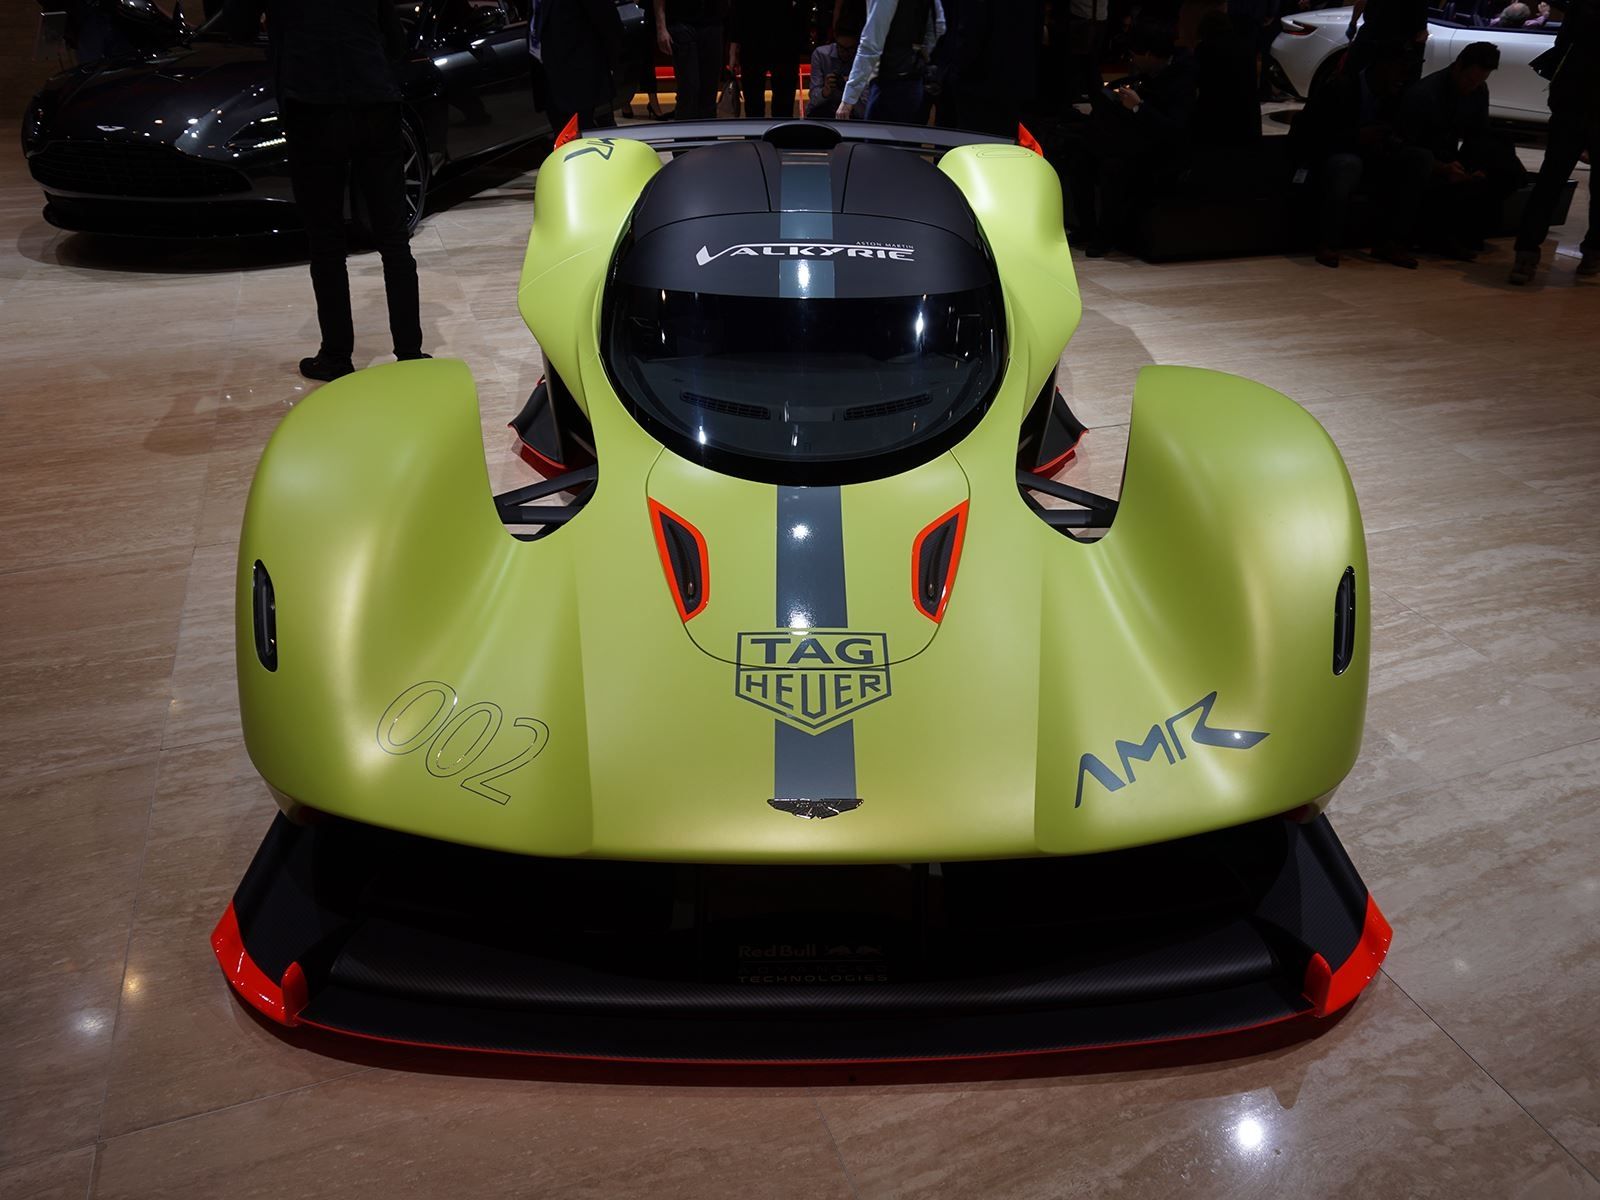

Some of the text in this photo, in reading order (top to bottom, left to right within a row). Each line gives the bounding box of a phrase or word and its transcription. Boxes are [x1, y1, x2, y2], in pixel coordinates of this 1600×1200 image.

[696, 243, 915, 266] VALKYRIE
[750, 638, 874, 665] TAG
[746, 674, 881, 720] HEUER
[377, 680, 550, 806] 002
[1074, 691, 1271, 809] AMR
[738, 975, 888, 983] TECHNOLOGIES
